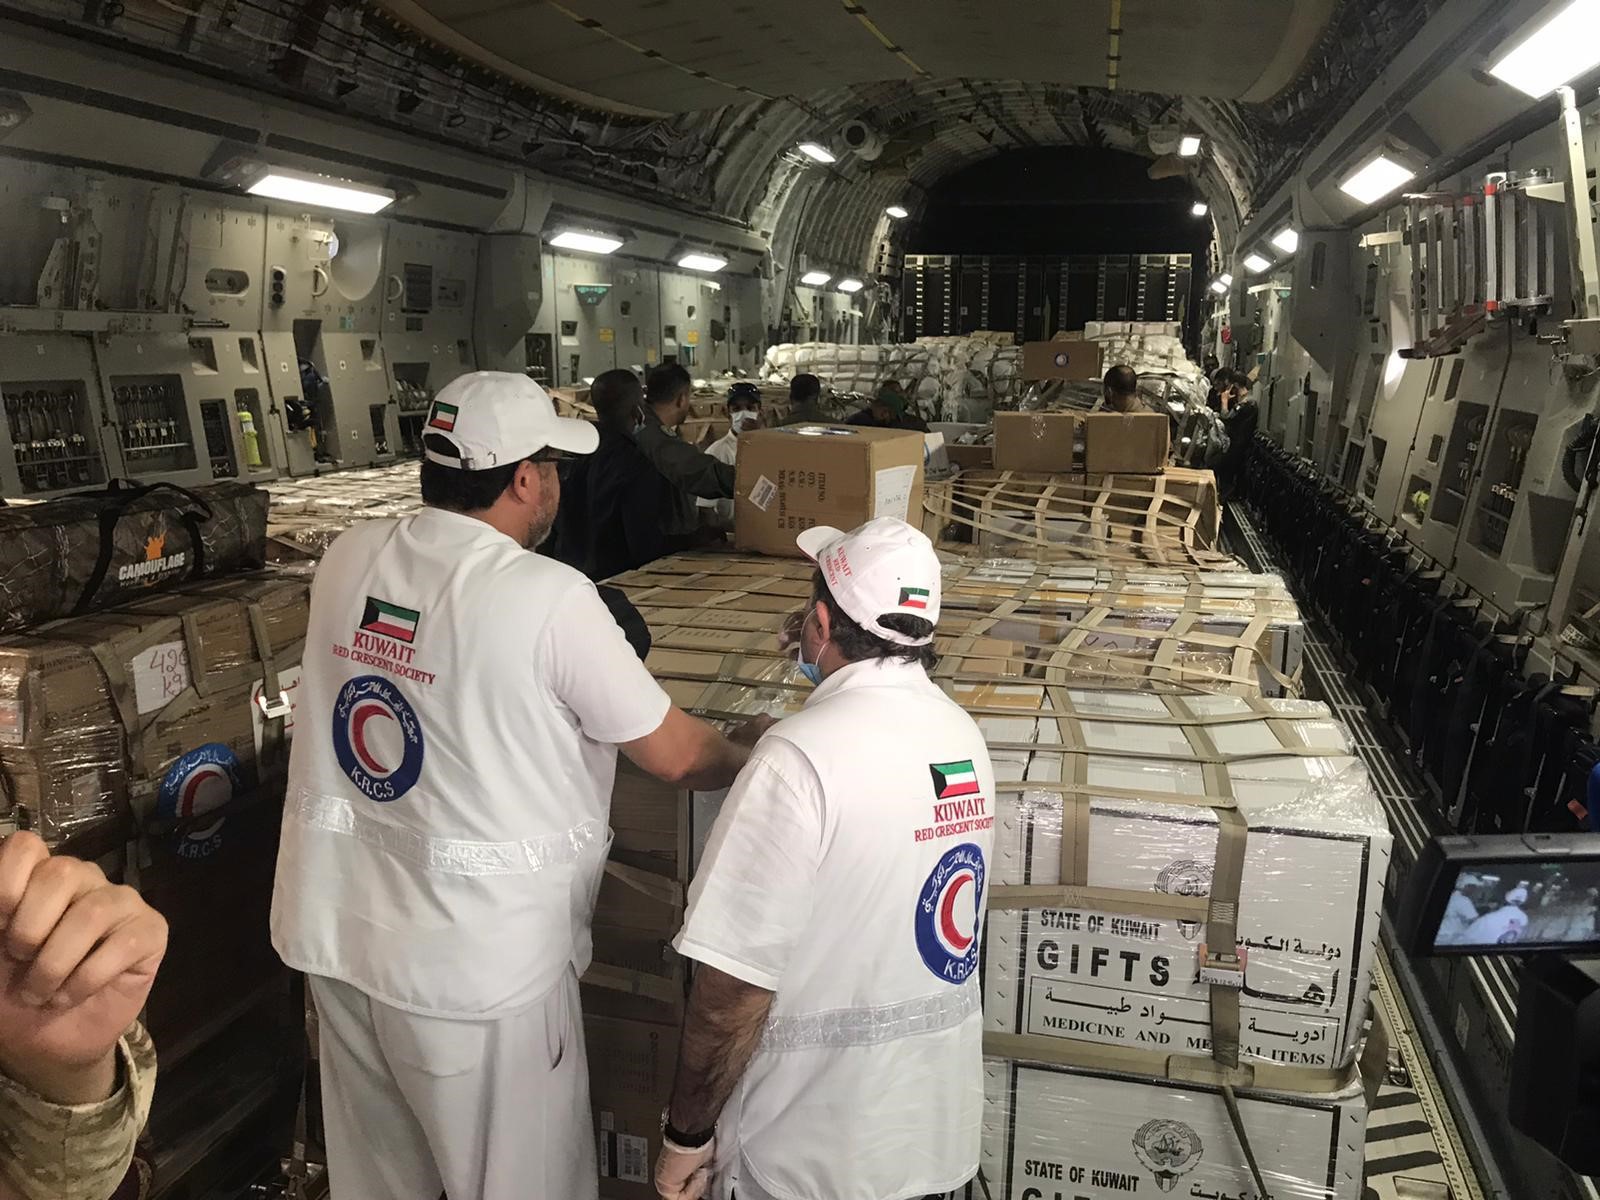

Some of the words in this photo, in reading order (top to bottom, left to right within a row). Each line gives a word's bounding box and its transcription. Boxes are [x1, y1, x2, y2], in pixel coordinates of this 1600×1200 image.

[119, 552, 185, 580] CAMOUFLAGE
[838, 546, 853, 577] KUWAIT
[353, 631, 416, 664] KUWAIT
[332, 644, 349, 658] RED
[351, 650, 393, 673] CRESCENT
[393, 663, 436, 685] SOCIETY
[933, 798, 985, 823] KUWAIT
[914, 827, 934, 842] RED
[935, 820, 974, 838] CRESCENT
[1041, 909, 1081, 931] STATE
[1088, 915, 1105, 933] OF
[1111, 918, 1161, 940] KUWAIT
[1037, 939, 1170, 987] GIFTS
[1043, 1016, 1125, 1039] MEDICINE
[1136, 1030, 1171, 1045] AND
[1271, 1049, 1325, 1065] ITEMS
[1024, 1160, 1062, 1180] STATE
[1069, 1166, 1085, 1183] OF
[1091, 1169, 1140, 1192] KUWAIT
